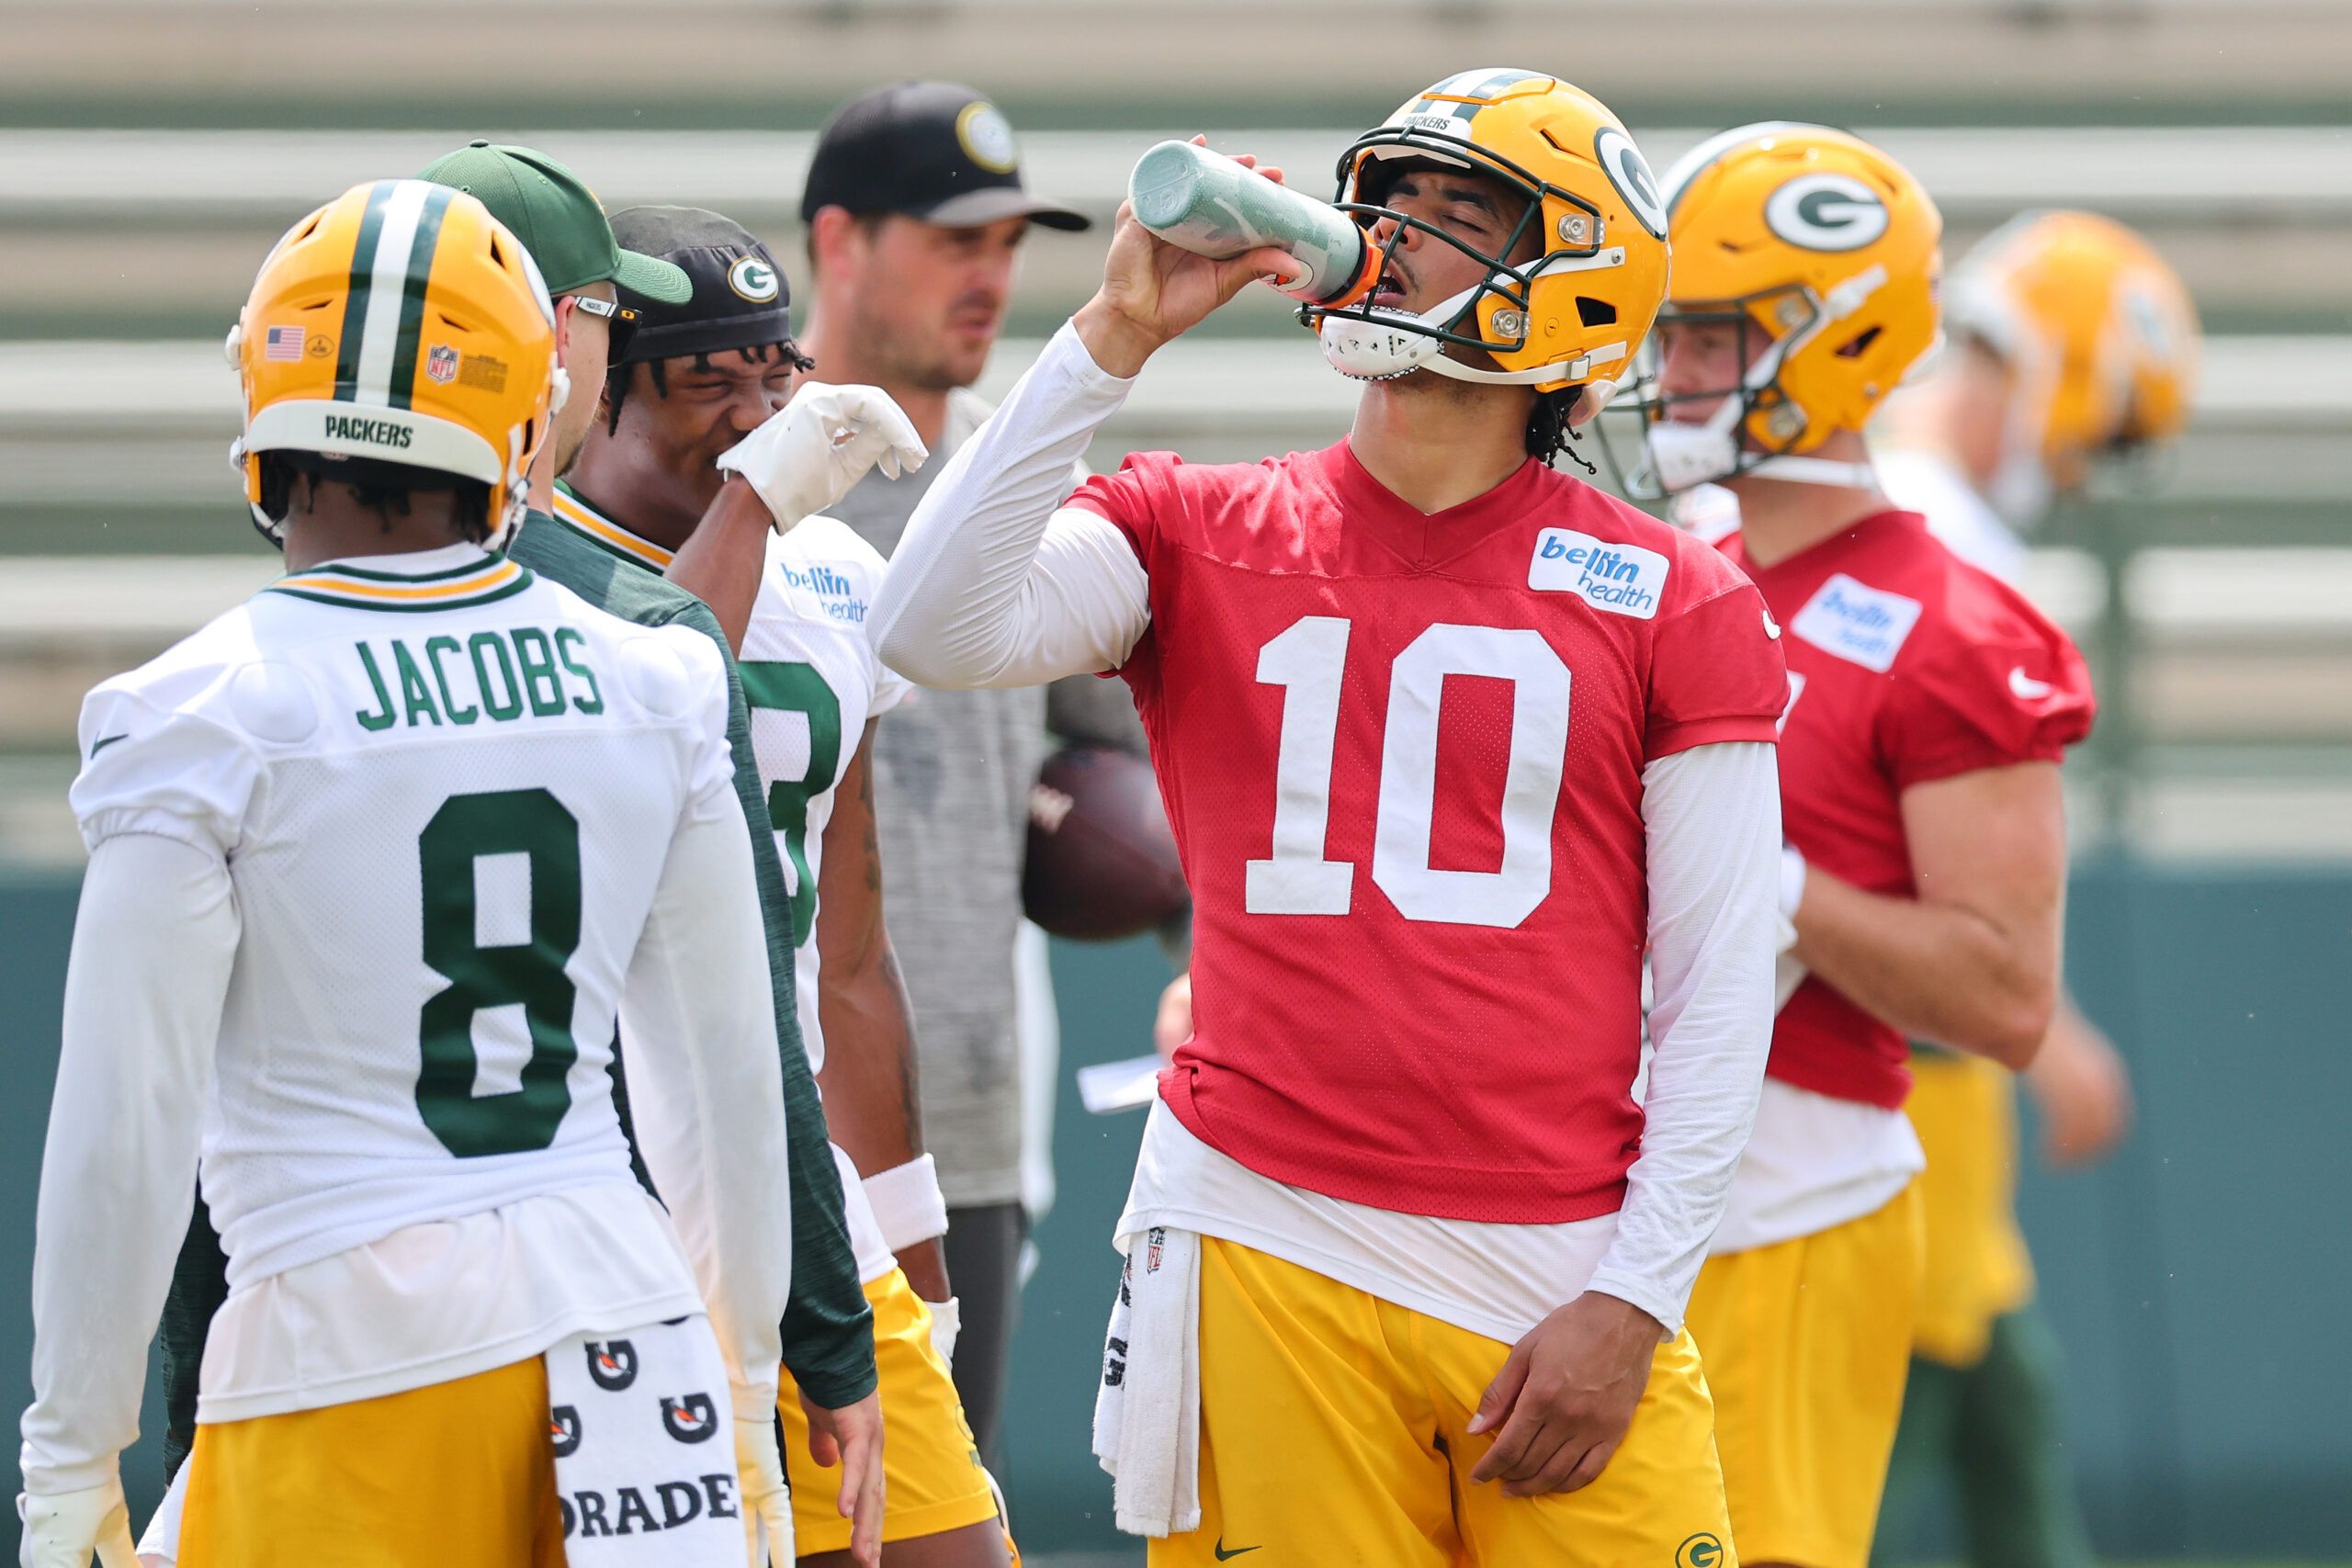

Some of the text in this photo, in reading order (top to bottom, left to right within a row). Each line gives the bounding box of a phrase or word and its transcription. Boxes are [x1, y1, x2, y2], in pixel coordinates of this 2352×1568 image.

[1401, 116, 1451, 130] PACKERS
[731, 258, 779, 299] G
[431, 358, 453, 378] NFL
[325, 414, 413, 449] PACKERS
[781, 562, 851, 595] bellin
[1541, 536, 1640, 583] bellin
[1577, 570, 1653, 610] health
[356, 626, 605, 732] JACOBS
[1245, 615, 1573, 930] 10
[414, 786, 582, 1158] 8
[583, 1338, 639, 1393] G
[659, 1392, 718, 1445] G
